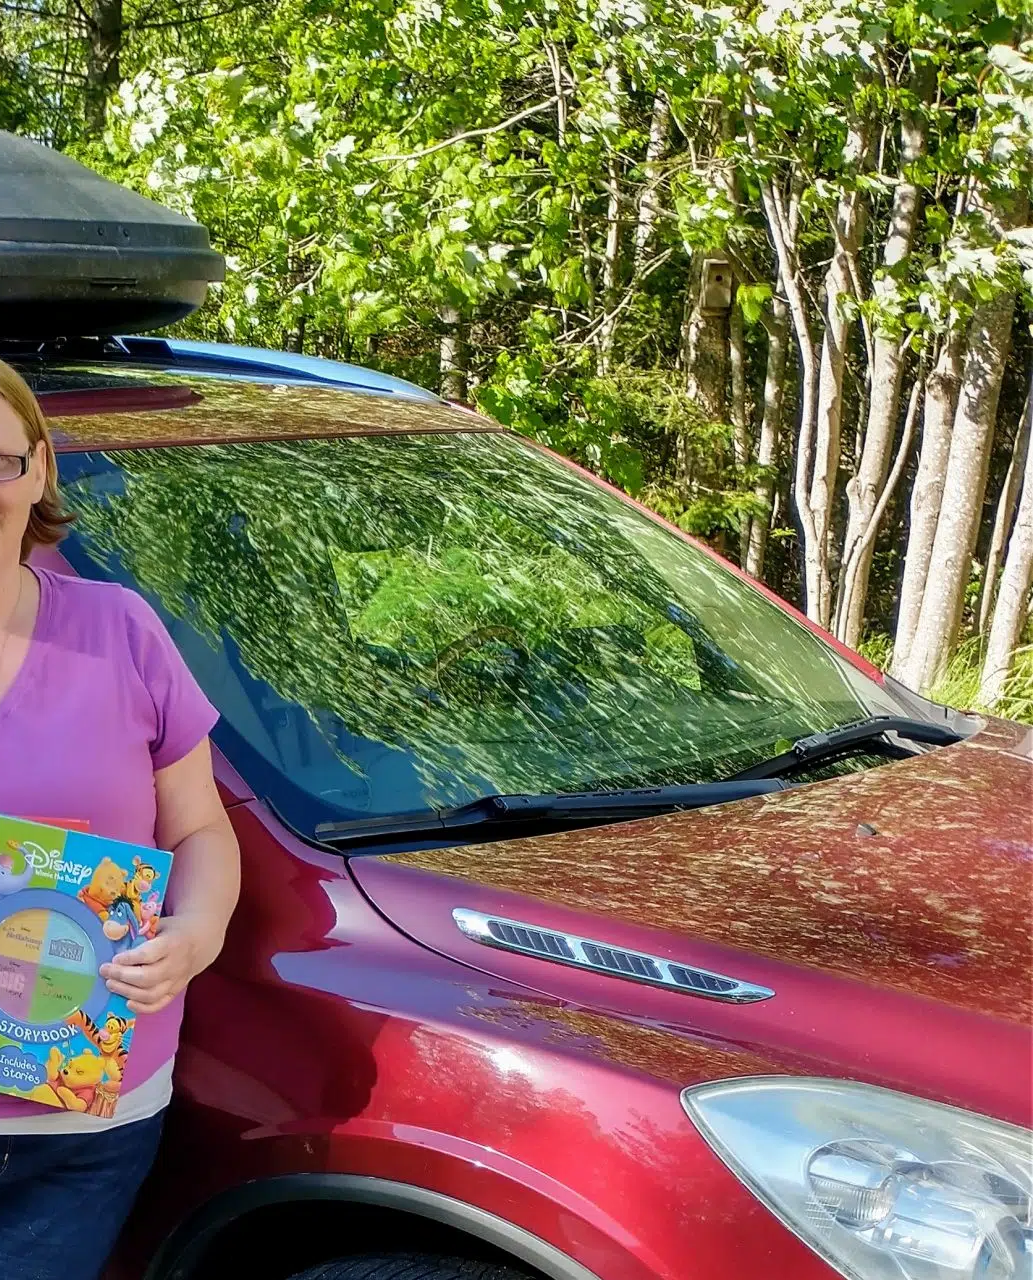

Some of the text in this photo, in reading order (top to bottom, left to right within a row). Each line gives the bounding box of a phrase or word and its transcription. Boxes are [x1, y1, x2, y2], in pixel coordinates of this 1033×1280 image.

[23, 841, 93, 885] Disney
[0, 1020, 78, 1042] STORYBOOK
[0, 1055, 37, 1072] Includes
[2, 1067, 40, 1084] Stories
